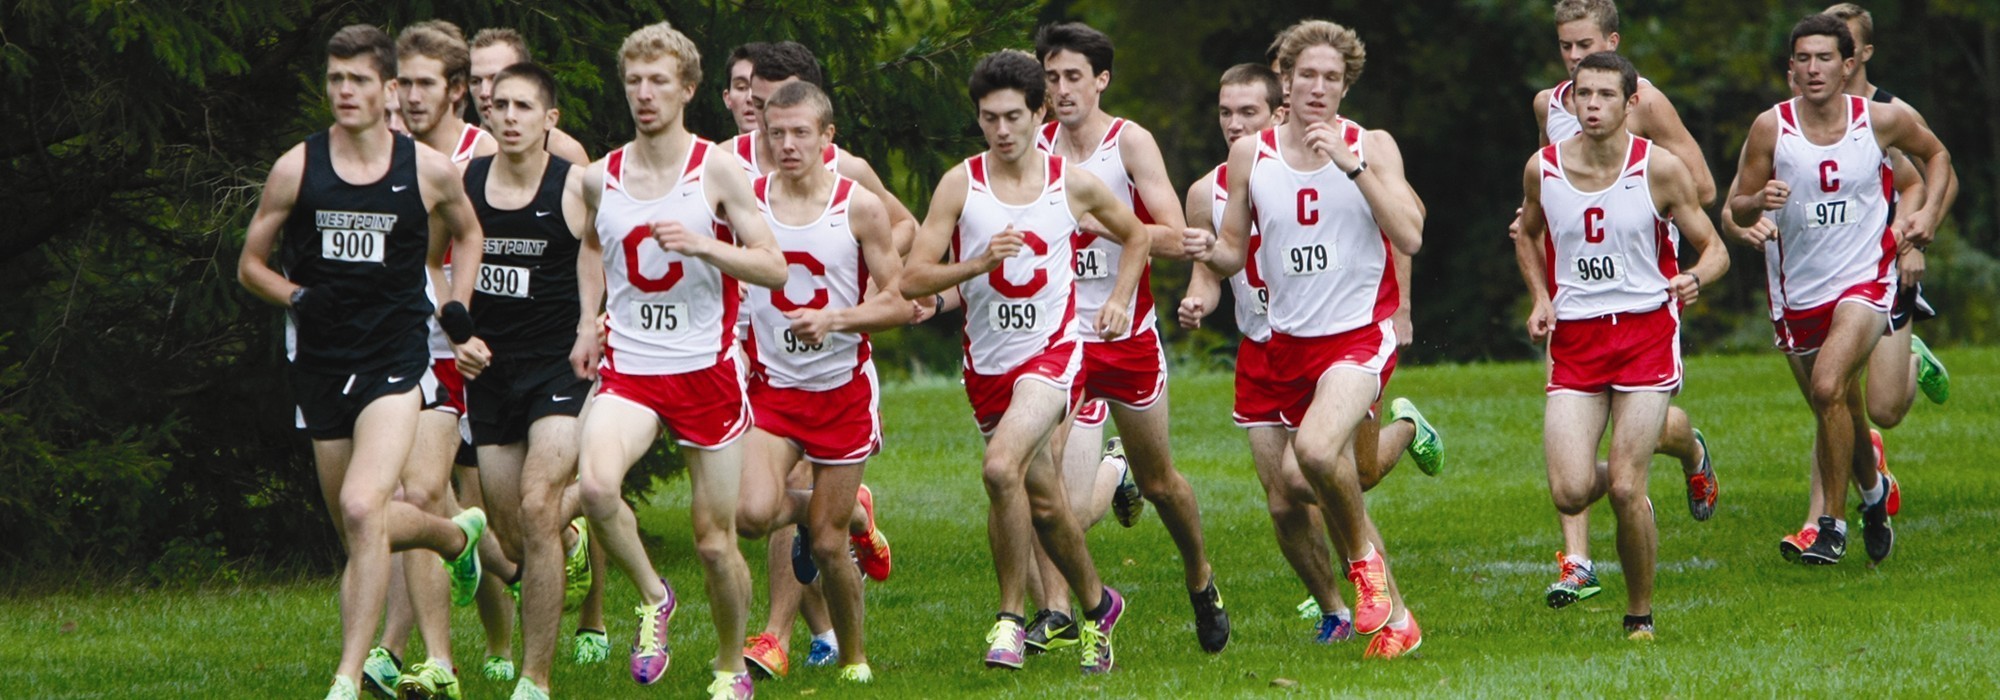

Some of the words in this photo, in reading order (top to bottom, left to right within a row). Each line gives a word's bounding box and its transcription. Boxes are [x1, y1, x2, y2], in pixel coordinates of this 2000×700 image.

[1819, 160, 1840, 193] C
[315, 210, 353, 229] WEST
[353, 212, 398, 232] POINT
[1296, 188, 1319, 226] C
[1816, 201, 1847, 225] 977
[1584, 207, 1605, 244] C
[332, 231, 374, 259] 900
[482, 238, 504, 255] EST
[504, 239, 548, 256] POINT
[622, 224, 684, 293] C
[1290, 244, 1328, 272] 979
[989, 230, 1048, 298] C
[1075, 250, 1099, 277] 64
[1577, 255, 1615, 281] 960
[480, 265, 519, 295] 890
[771, 250, 829, 312] C
[640, 304, 678, 331] 975
[997, 303, 1036, 330] 959
